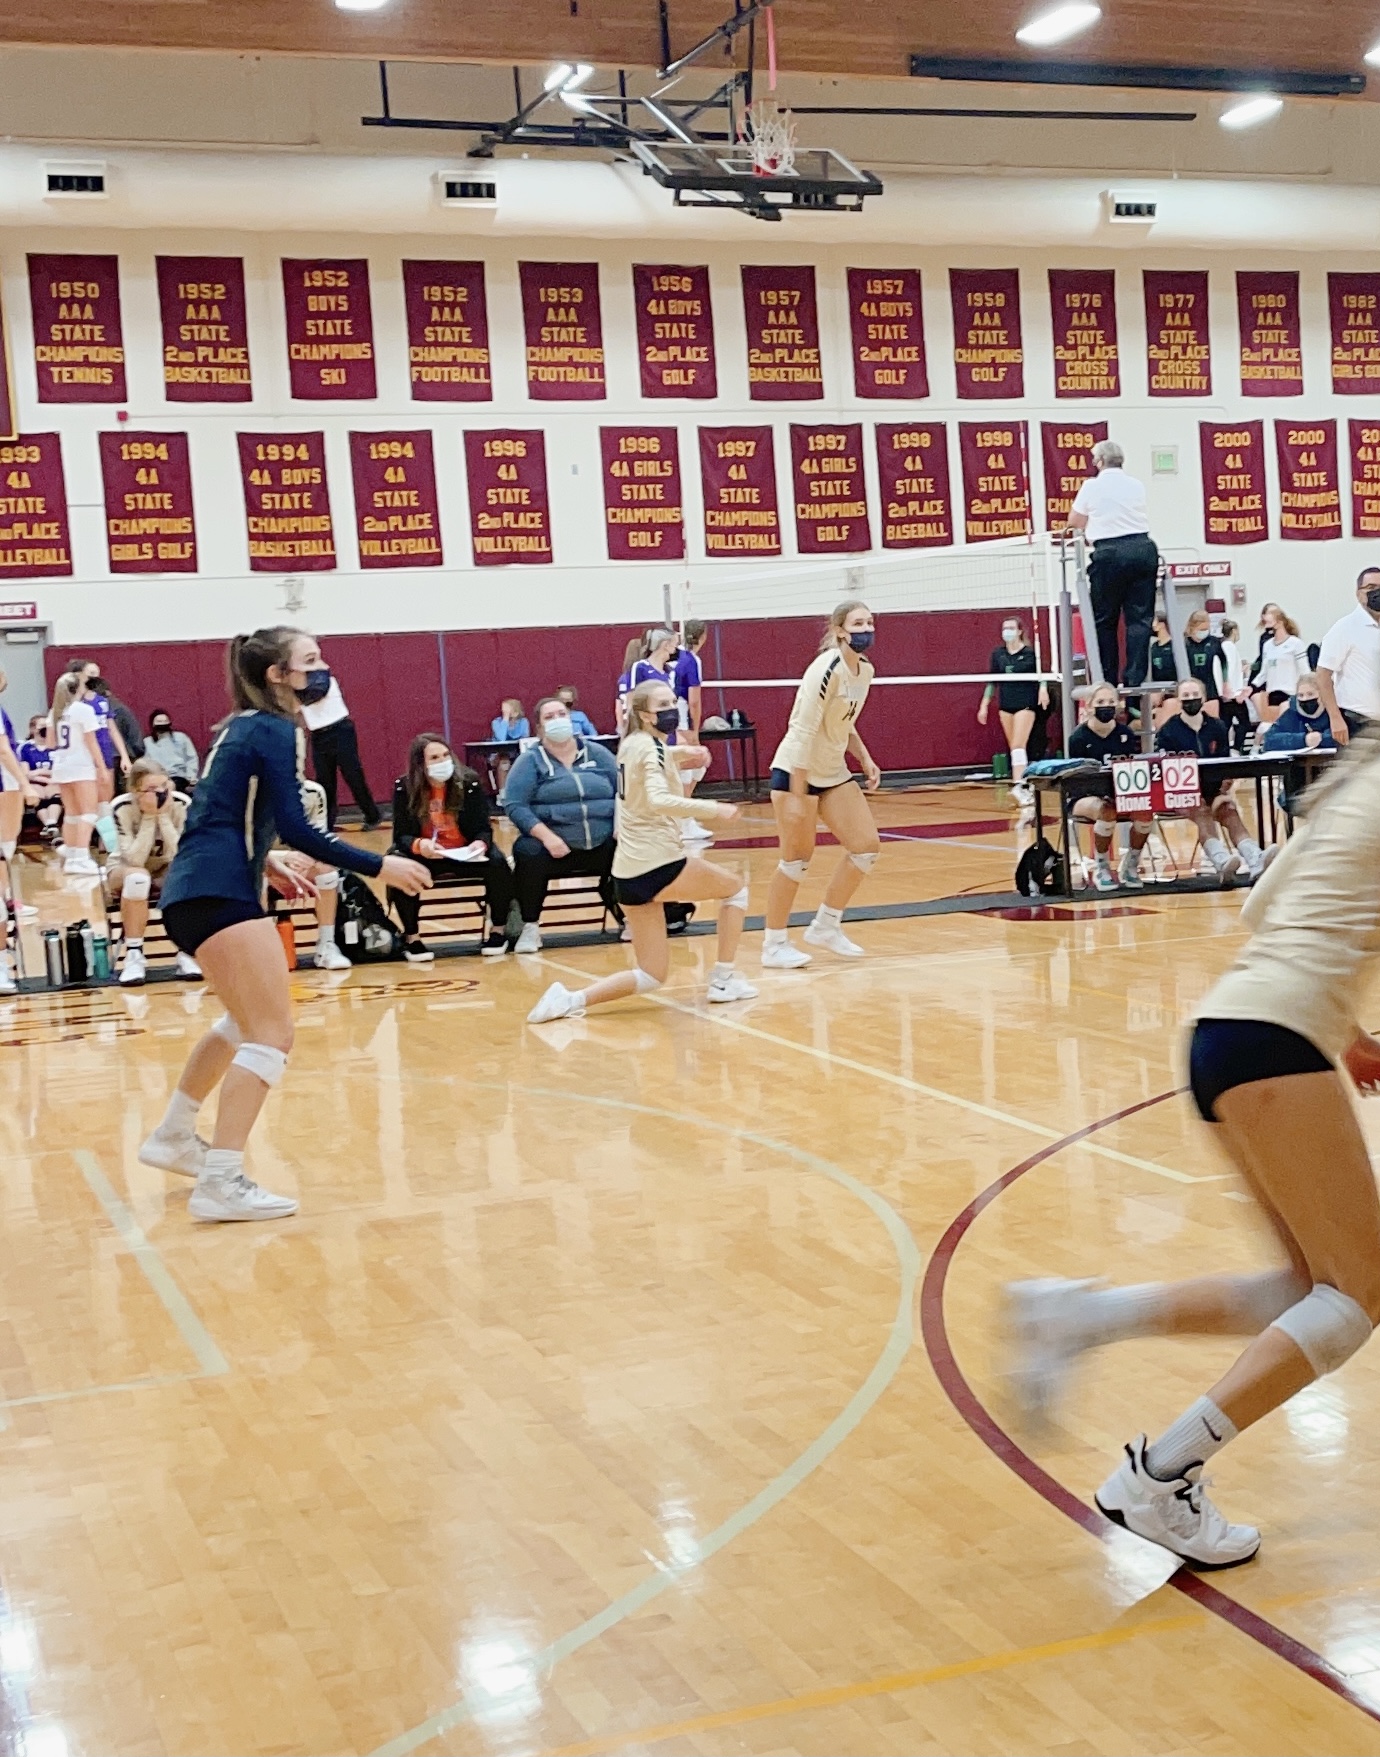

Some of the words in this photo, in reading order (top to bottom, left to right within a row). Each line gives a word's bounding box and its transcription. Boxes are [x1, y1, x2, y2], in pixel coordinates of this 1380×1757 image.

[304, 271, 349, 286] 1952
[51, 282, 99, 298] 1950
[179, 284, 225, 299] 1952
[424, 286, 468, 301] 1952
[867, 280, 903, 294] 1957
[540, 288, 582, 302] 1953
[760, 291, 800, 305] 1957
[1160, 294, 1194, 307] 1977
[59, 304, 94, 319] AAA
[186, 304, 221, 320] AAA
[431, 307, 463, 322] AAA
[547, 308, 578, 322] AAA
[647, 300, 665, 315] 4A
[860, 302, 877, 316] 4A
[768, 310, 797, 324] AAA
[973, 312, 1001, 326] AAA
[1072, 312, 1097, 326] AAA
[1165, 312, 1190, 326] AAA
[1257, 312, 1282, 325] AAA
[1348, 313, 1372, 325] AAA
[51, 325, 105, 341] STATE
[180, 325, 230, 341] STATE
[306, 320, 353, 335] STATE
[425, 327, 472, 342] STATE
[541, 327, 586, 342] STATE
[655, 323, 696, 339] STATE
[868, 324, 908, 339] STATE
[762, 329, 804, 344] STATE
[968, 330, 1008, 344] STATE
[1067, 330, 1105, 344] STATE
[1160, 330, 1197, 344] STATE
[1253, 330, 1289, 343] STATE
[1343, 330, 1379, 343] STATE
[35, 346, 124, 362] CHAMPIONS
[196, 347, 248, 363] PLACE
[291, 343, 371, 360] CHAMPIONS
[409, 347, 490, 363] CHAMPIONS
[526, 347, 604, 363] CHAMPIONS
[669, 346, 709, 362] PLACE
[775, 349, 819, 363] PLACE
[877, 347, 920, 362] PLACE
[954, 349, 1023, 363] CHAMPIONS
[1078, 345, 1118, 359] PLACE
[1170, 345, 1209, 359] PLACE
[1260, 348, 1300, 361] PLACE
[527, 366, 604, 382] FOOTBALL
[749, 367, 822, 382] BASKETBALL
[972, 368, 1007, 381] GOLF
[1066, 361, 1108, 374] CROSS
[1159, 360, 1200, 374] CROSS
[50, 367, 112, 383] TENNIS
[164, 367, 251, 383] BASKETBALL
[320, 369, 346, 384] SKI
[411, 367, 491, 383] FOOTBALL
[663, 369, 696, 385] GOLF
[1152, 375, 1207, 389] COUNTRY
[1059, 376, 1116, 390] COUNTRY
[619, 437, 660, 453] 1996
[808, 435, 846, 450] 1997
[1058, 433, 1095, 448] 1999
[121, 443, 168, 460] 1994
[257, 444, 309, 460] 1994
[370, 442, 415, 459] 1994
[484, 440, 526, 457] 1996
[718, 441, 756, 457] 1997
[801, 459, 819, 474] 4A
[904, 456, 922, 471] 4A
[988, 454, 1005, 469] 4A
[1068, 455, 1087, 469] 4A
[1225, 454, 1242, 468] 4A
[1299, 452, 1316, 466] 4A
[136, 468, 158, 484] 4A
[384, 467, 406, 483] 4A
[498, 465, 517, 480] 4A
[610, 461, 629, 476] 4A
[728, 465, 746, 480] 4A
[7, 472, 31, 488] 4A
[249, 469, 272, 485] 4A
[979, 476, 1017, 491] STATE
[1217, 475, 1251, 489] STATE
[1293, 472, 1327, 487] STATE
[622, 484, 664, 500] STATE
[810, 480, 850, 496] STATE
[896, 478, 934, 494] STATE
[125, 493, 173, 510] STATE
[262, 493, 312, 509] STATE
[374, 491, 420, 507] STATE
[487, 488, 530, 504] STATE
[720, 488, 760, 503] STATE
[607, 507, 683, 523] CHAMPIONS
[797, 501, 865, 519] CHAMPIONS
[908, 500, 944, 515] PLACE
[109, 517, 192, 535] CHAMPIONS
[248, 515, 330, 533] CHAMPIONS
[388, 513, 433, 531] PLACE
[503, 512, 543, 528] PLACE
[706, 511, 776, 526] CHAMPIONS
[887, 523, 948, 540] BASEBALL
[248, 539, 335, 557] BASKETBALL
